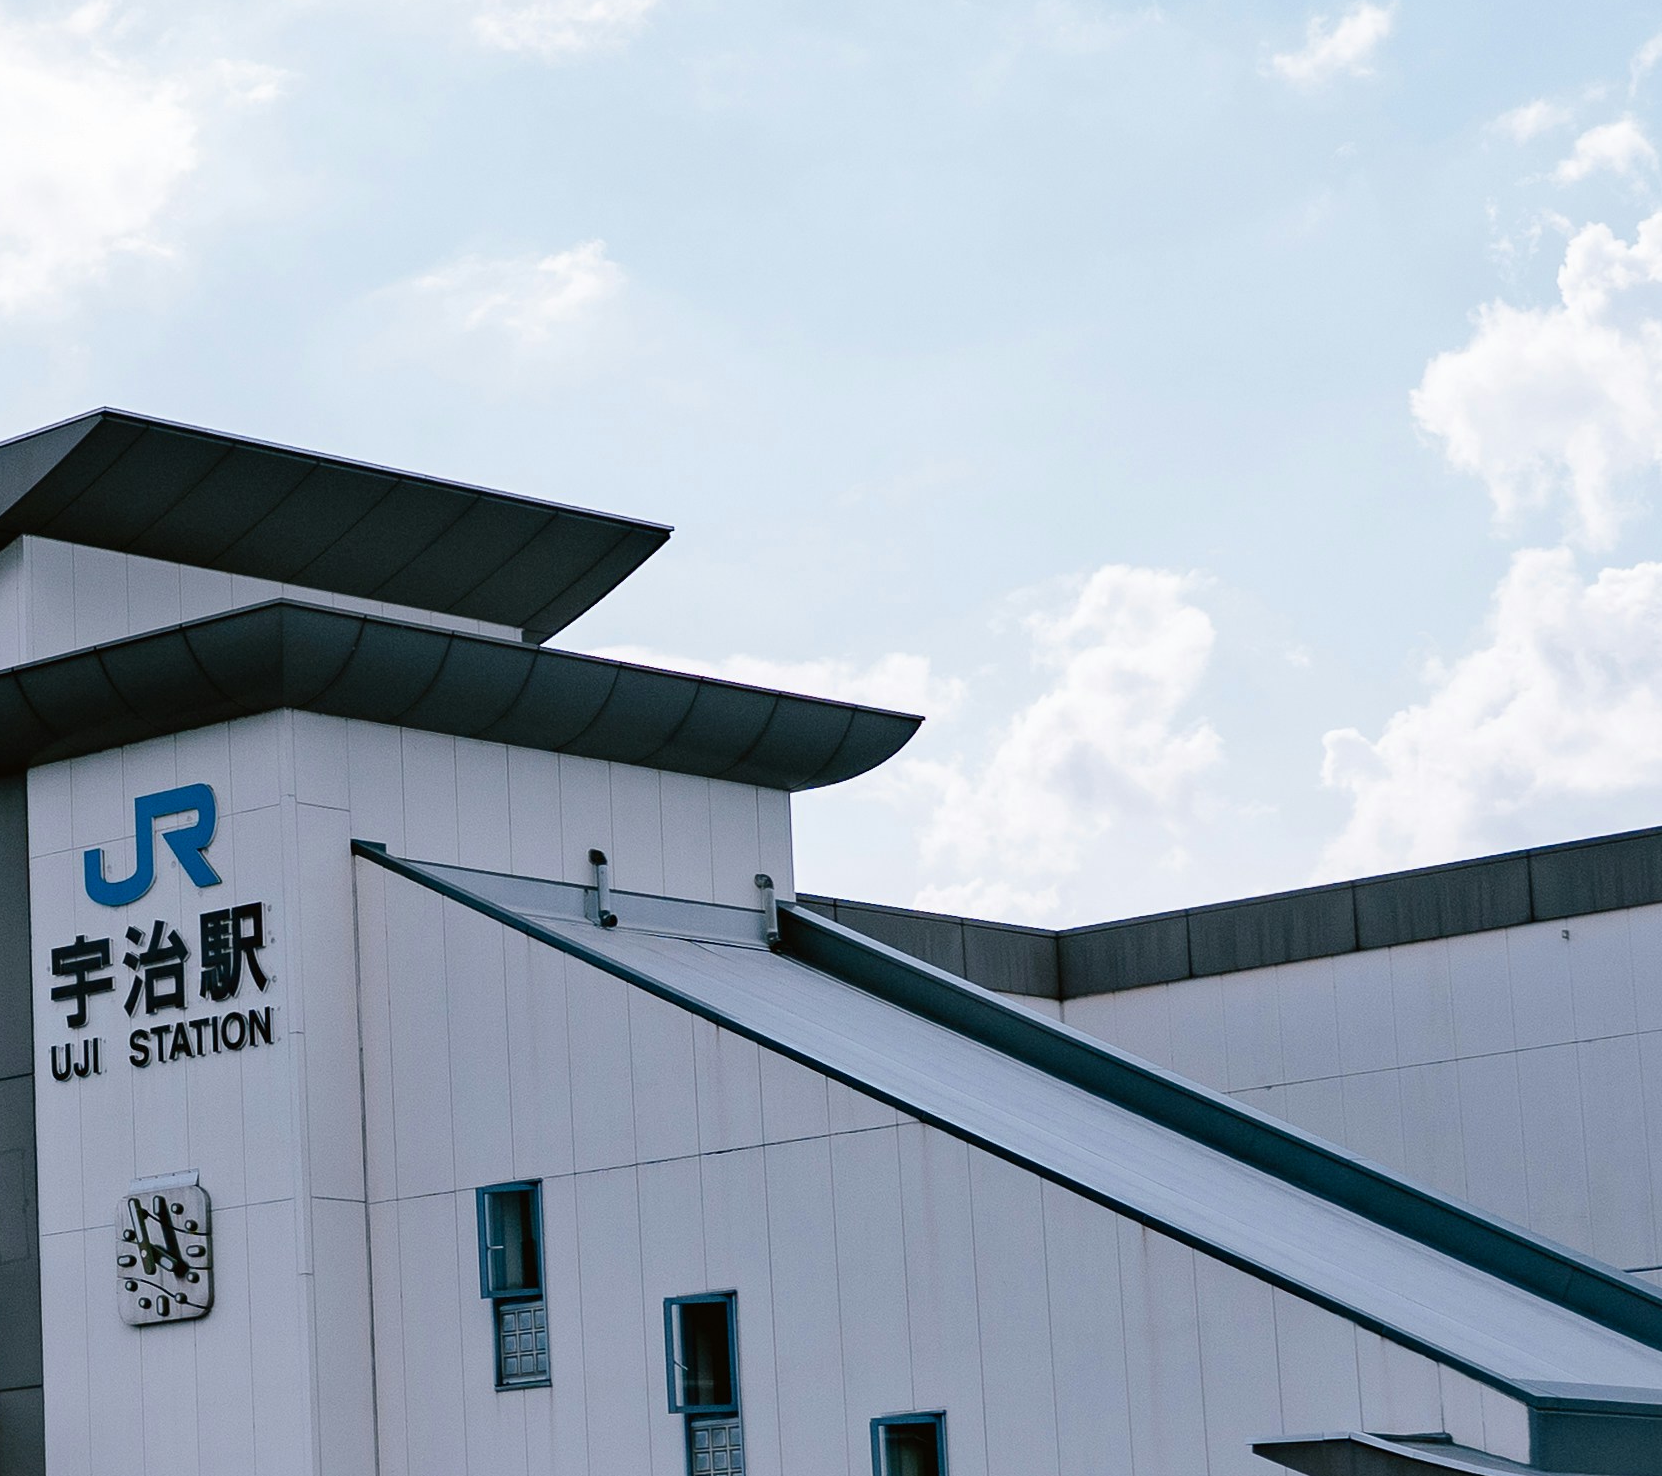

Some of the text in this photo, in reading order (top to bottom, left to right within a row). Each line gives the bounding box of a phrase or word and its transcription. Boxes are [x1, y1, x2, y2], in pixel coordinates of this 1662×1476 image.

[84, 783, 222, 907] JR
[51, 902, 270, 1030] 宇治駅
[51, 1006, 275, 1082] UJI STATION
